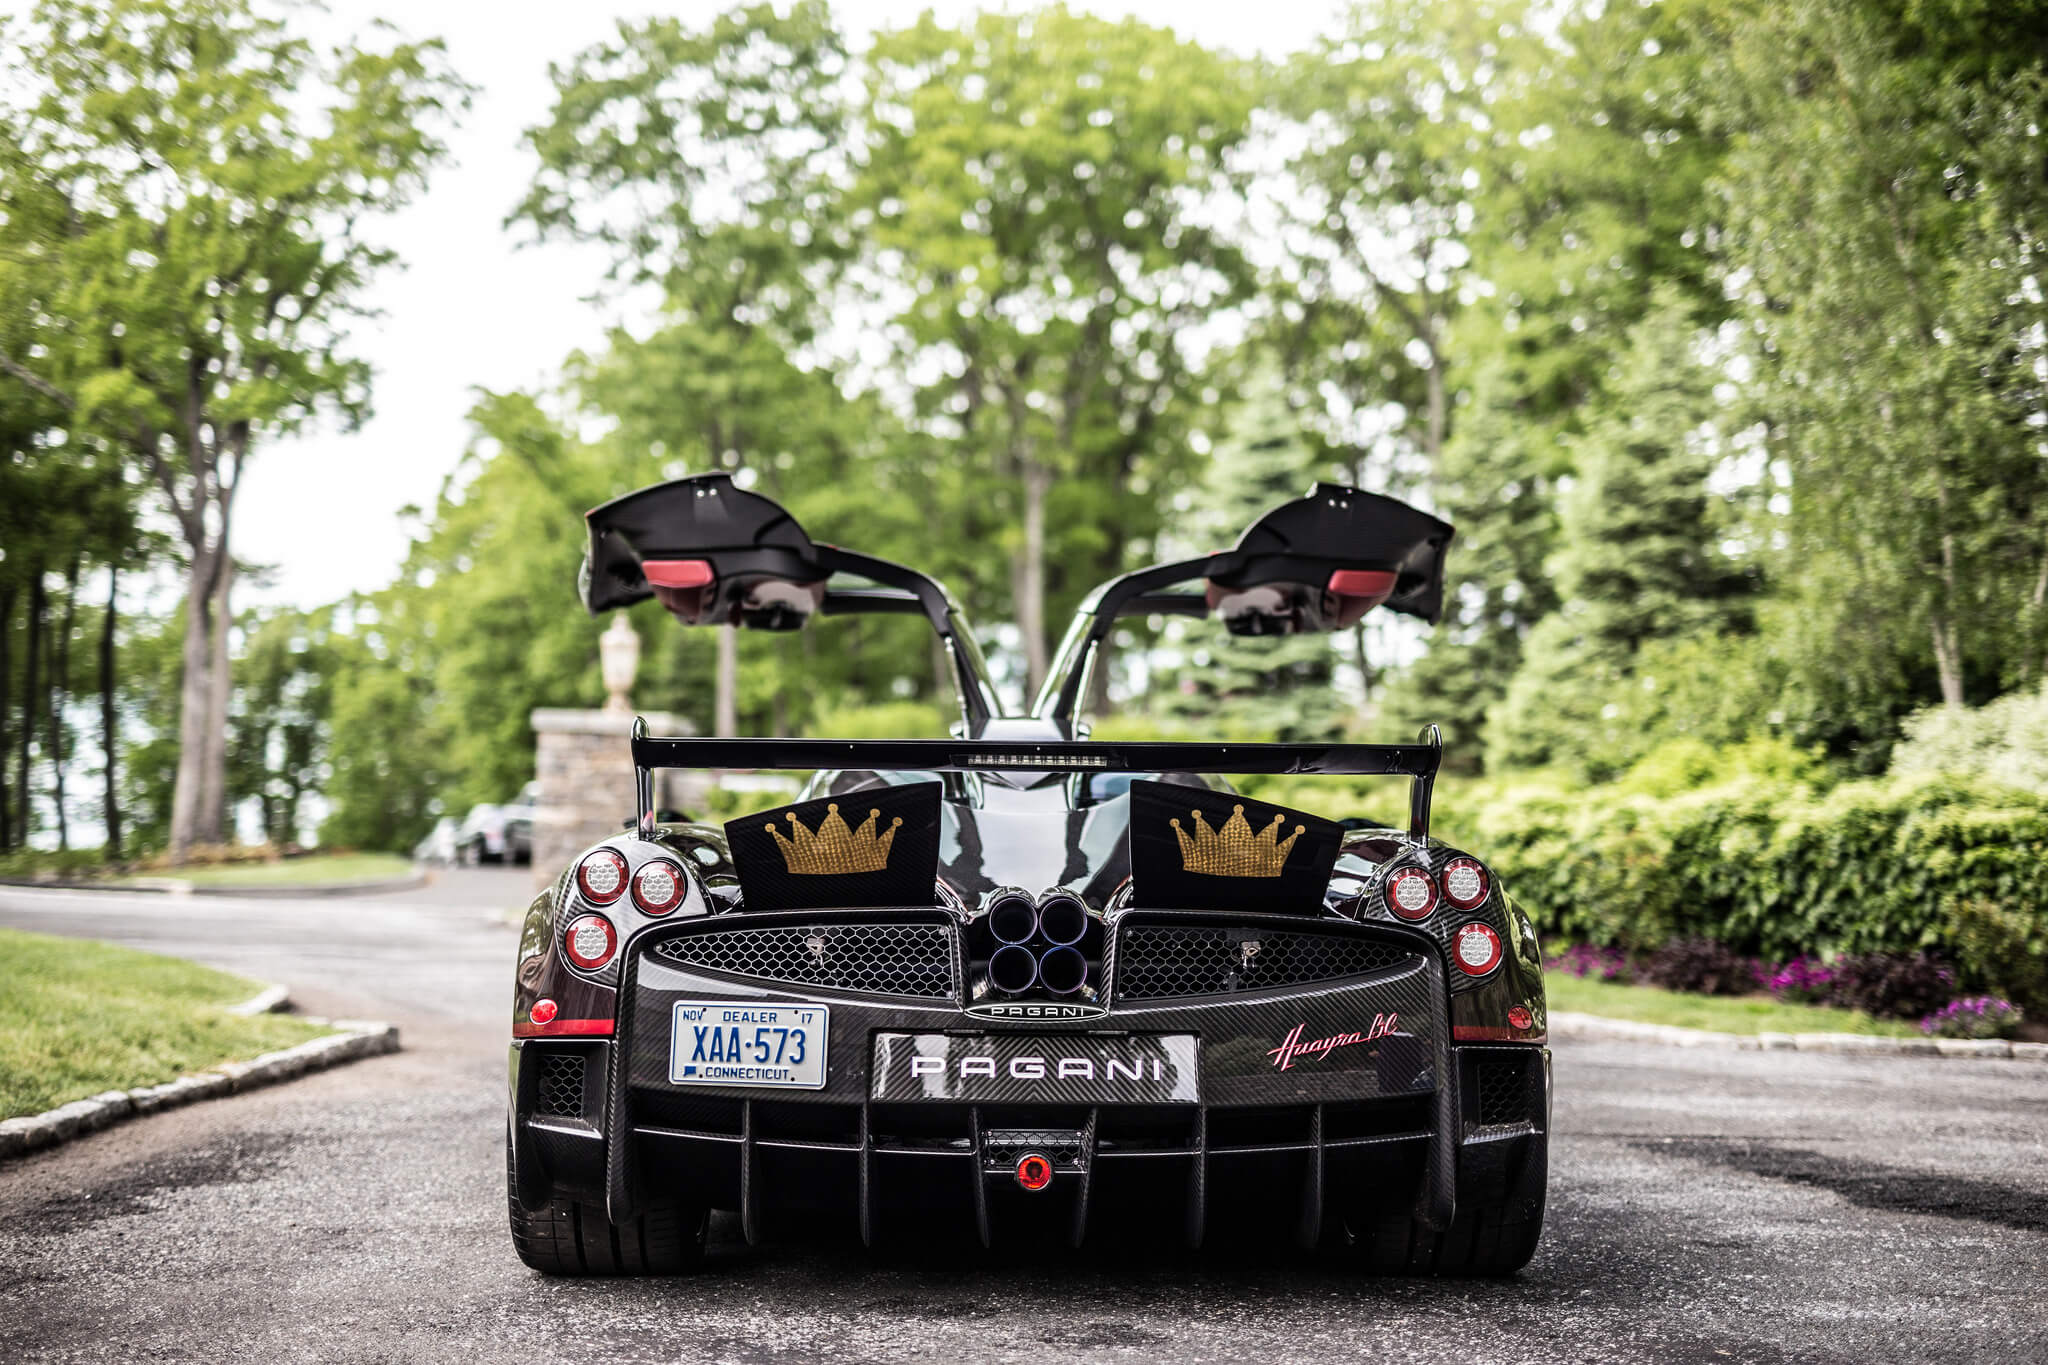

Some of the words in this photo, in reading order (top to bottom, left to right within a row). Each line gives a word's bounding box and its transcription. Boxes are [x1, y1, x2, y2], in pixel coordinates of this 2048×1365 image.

[683, 1010, 703, 1021] NOV
[723, 1011, 777, 1023] DEALER
[801, 1014, 813, 1025] 17
[991, 1006, 1084, 1017] PAGANI
[1266, 1023, 1362, 1071] Huayra
[705, 1066, 789, 1080] CONNECTICUT
[911, 1056, 1160, 1081] PAGANI
